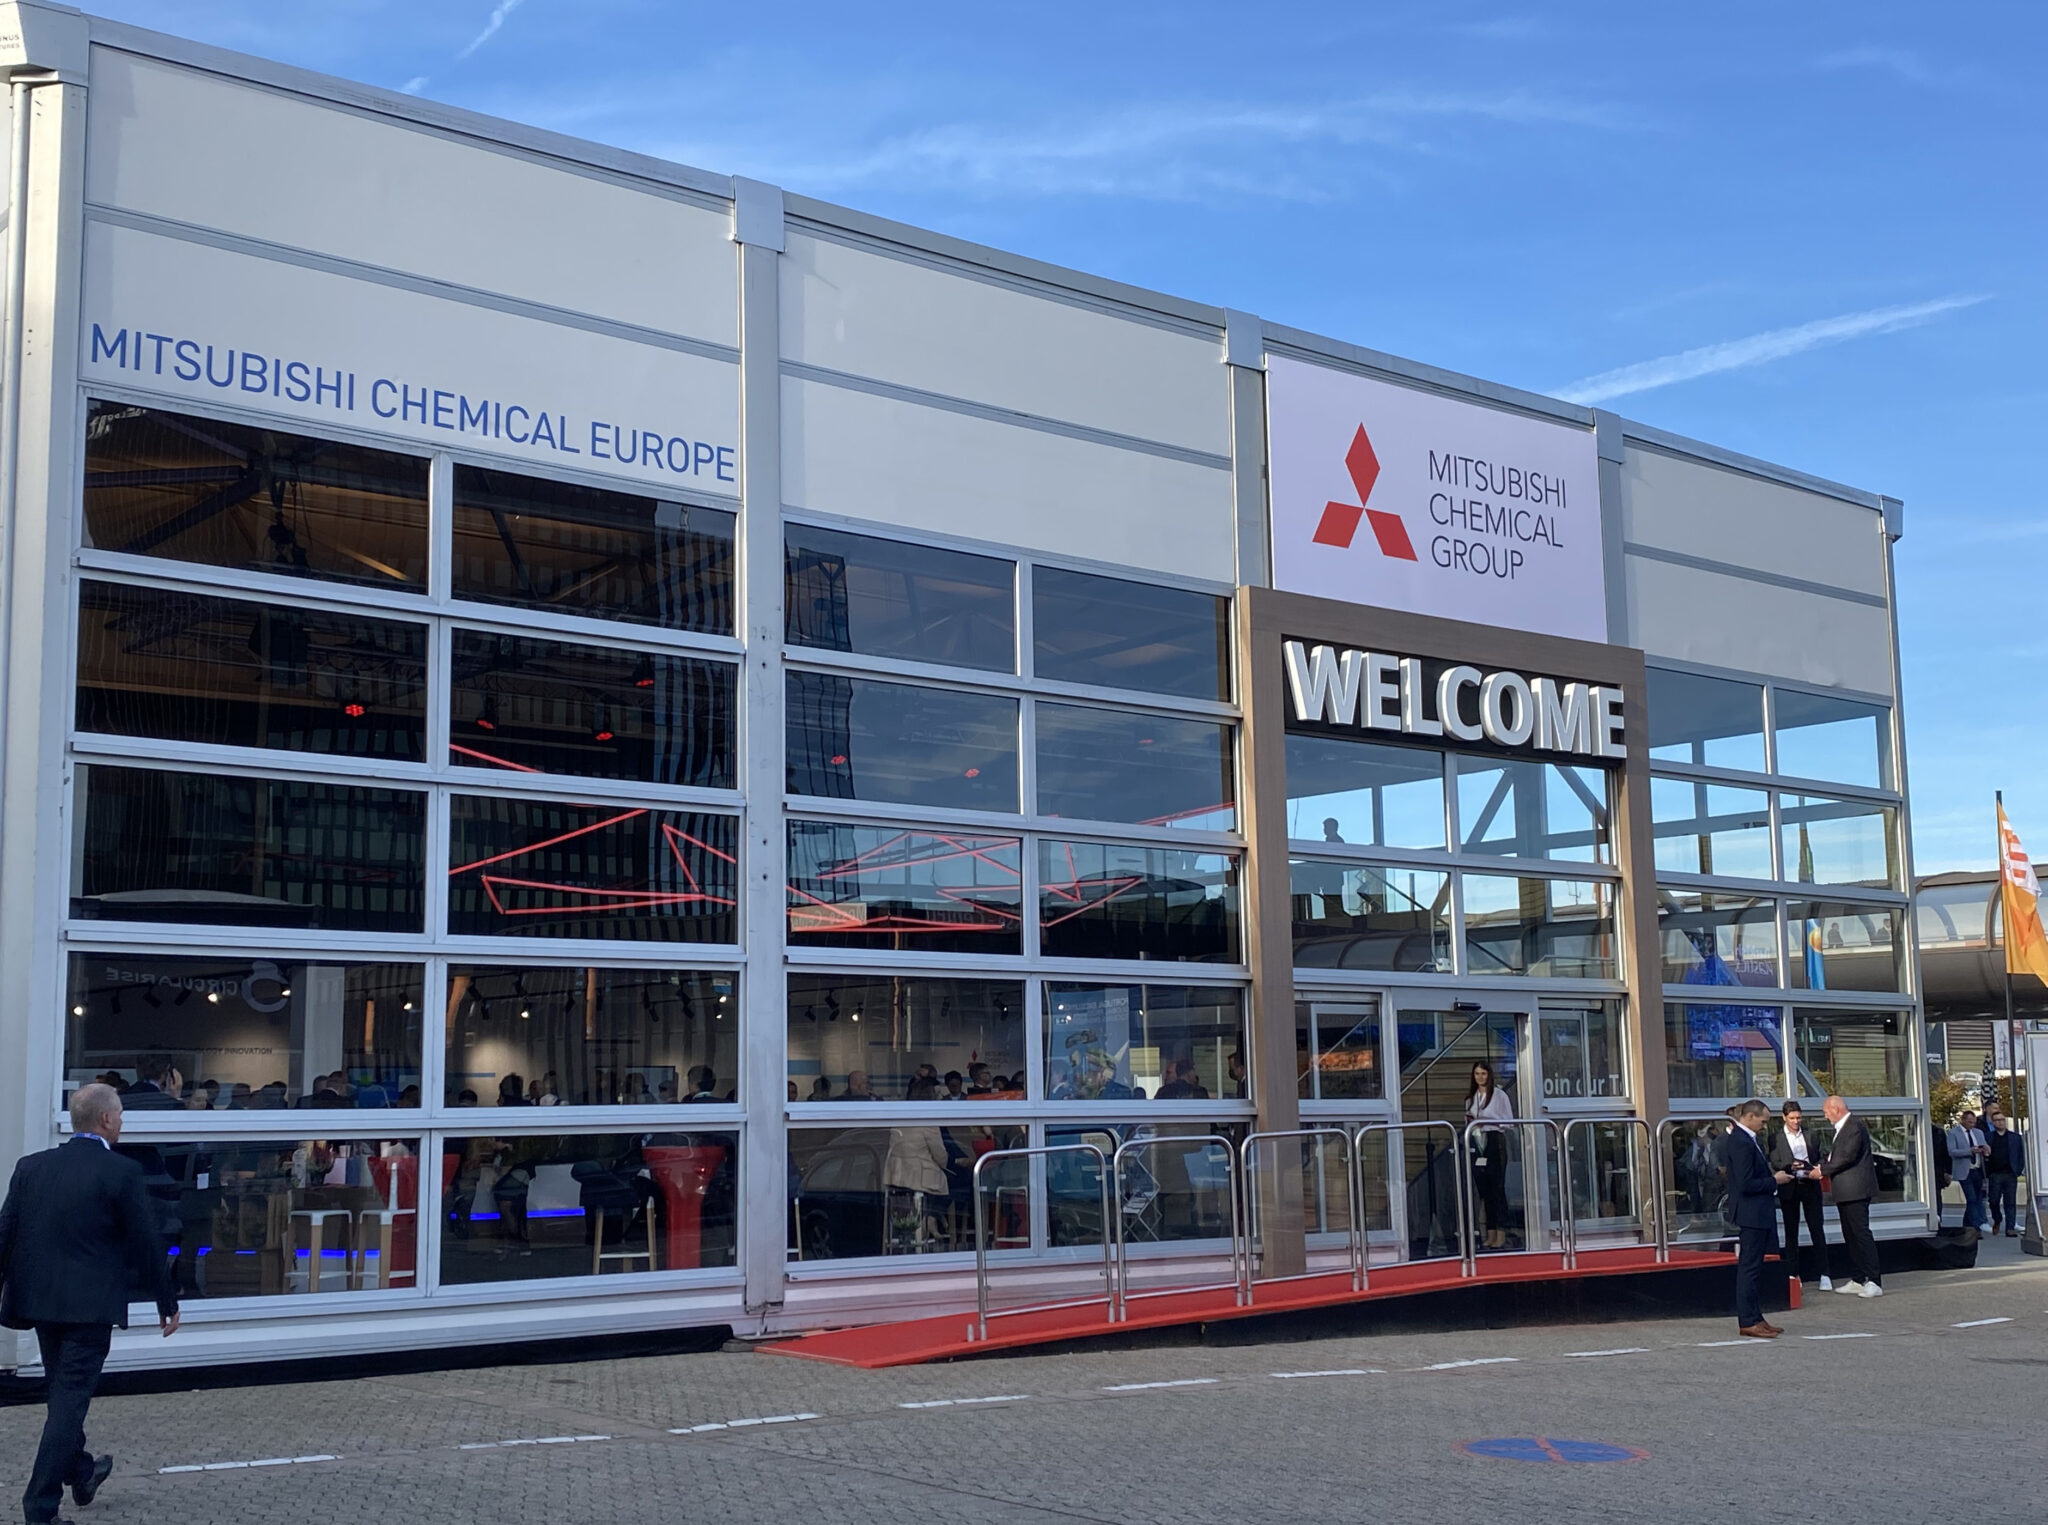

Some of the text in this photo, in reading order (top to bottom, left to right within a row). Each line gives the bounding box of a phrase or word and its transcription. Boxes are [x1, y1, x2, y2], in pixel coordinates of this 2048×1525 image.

[91, 323, 735, 482] MITSUBISHI CHEMICAL EUROPE
[1429, 450, 1566, 509] MITSUBISHI
[1430, 493, 1563, 548] CHEMICAL
[1432, 535, 1524, 580] GROUP
[1283, 640, 1627, 758] WELCOME
[1544, 1072, 1571, 1095] oin
[1608, 1074, 1623, 1095] T
